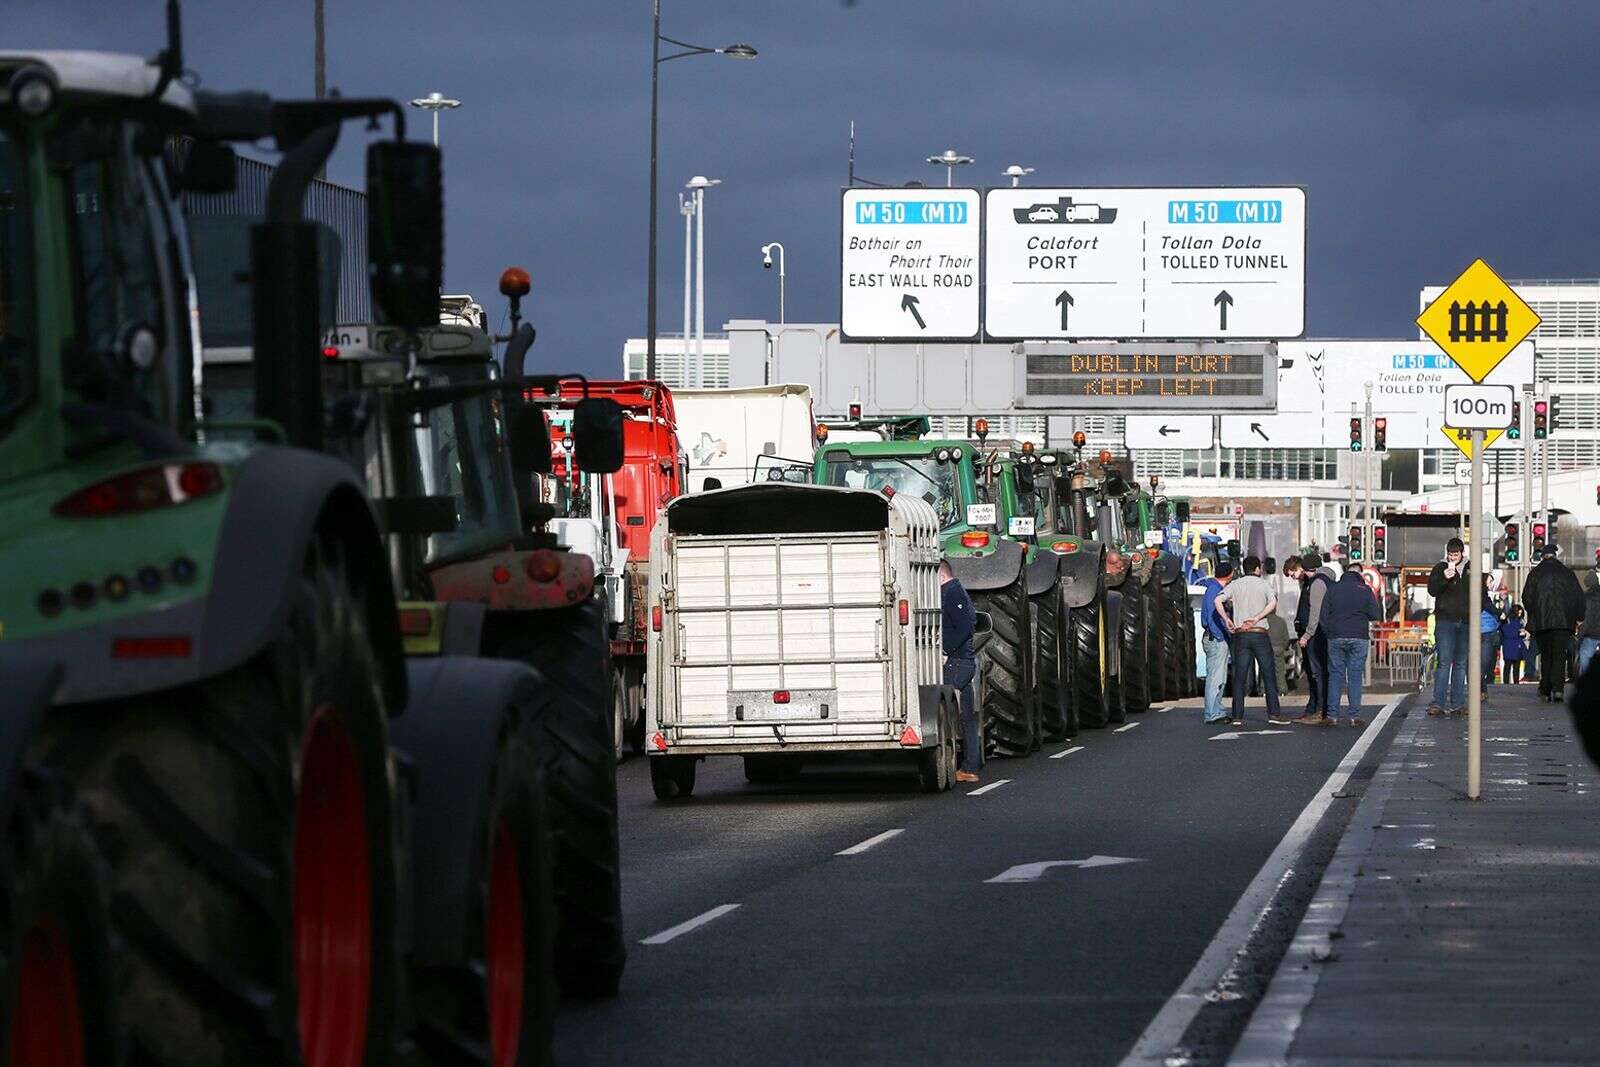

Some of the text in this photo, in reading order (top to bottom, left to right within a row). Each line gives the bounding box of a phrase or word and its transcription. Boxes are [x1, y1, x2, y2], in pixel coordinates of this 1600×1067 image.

[921, 202, 963, 223] (M1)
[1235, 202, 1277, 222] (M1)
[905, 240, 922, 250] an
[1027, 236, 1099, 249] Calafort
[1161, 235, 1262, 249] Tollan Dola
[889, 255, 973, 268] Phoirt Thoir
[1029, 255, 1078, 269] PORT
[1161, 255, 1288, 269] TOLLED TUNNEL
[849, 274, 973, 287] EAST WALL ROAD
[1071, 353, 1232, 373] DUBLIN PORT
[1084, 377, 1217, 396] KEEP LEFT
[1379, 385, 1424, 394] TOLLED
[1453, 398, 1506, 415] 100m
